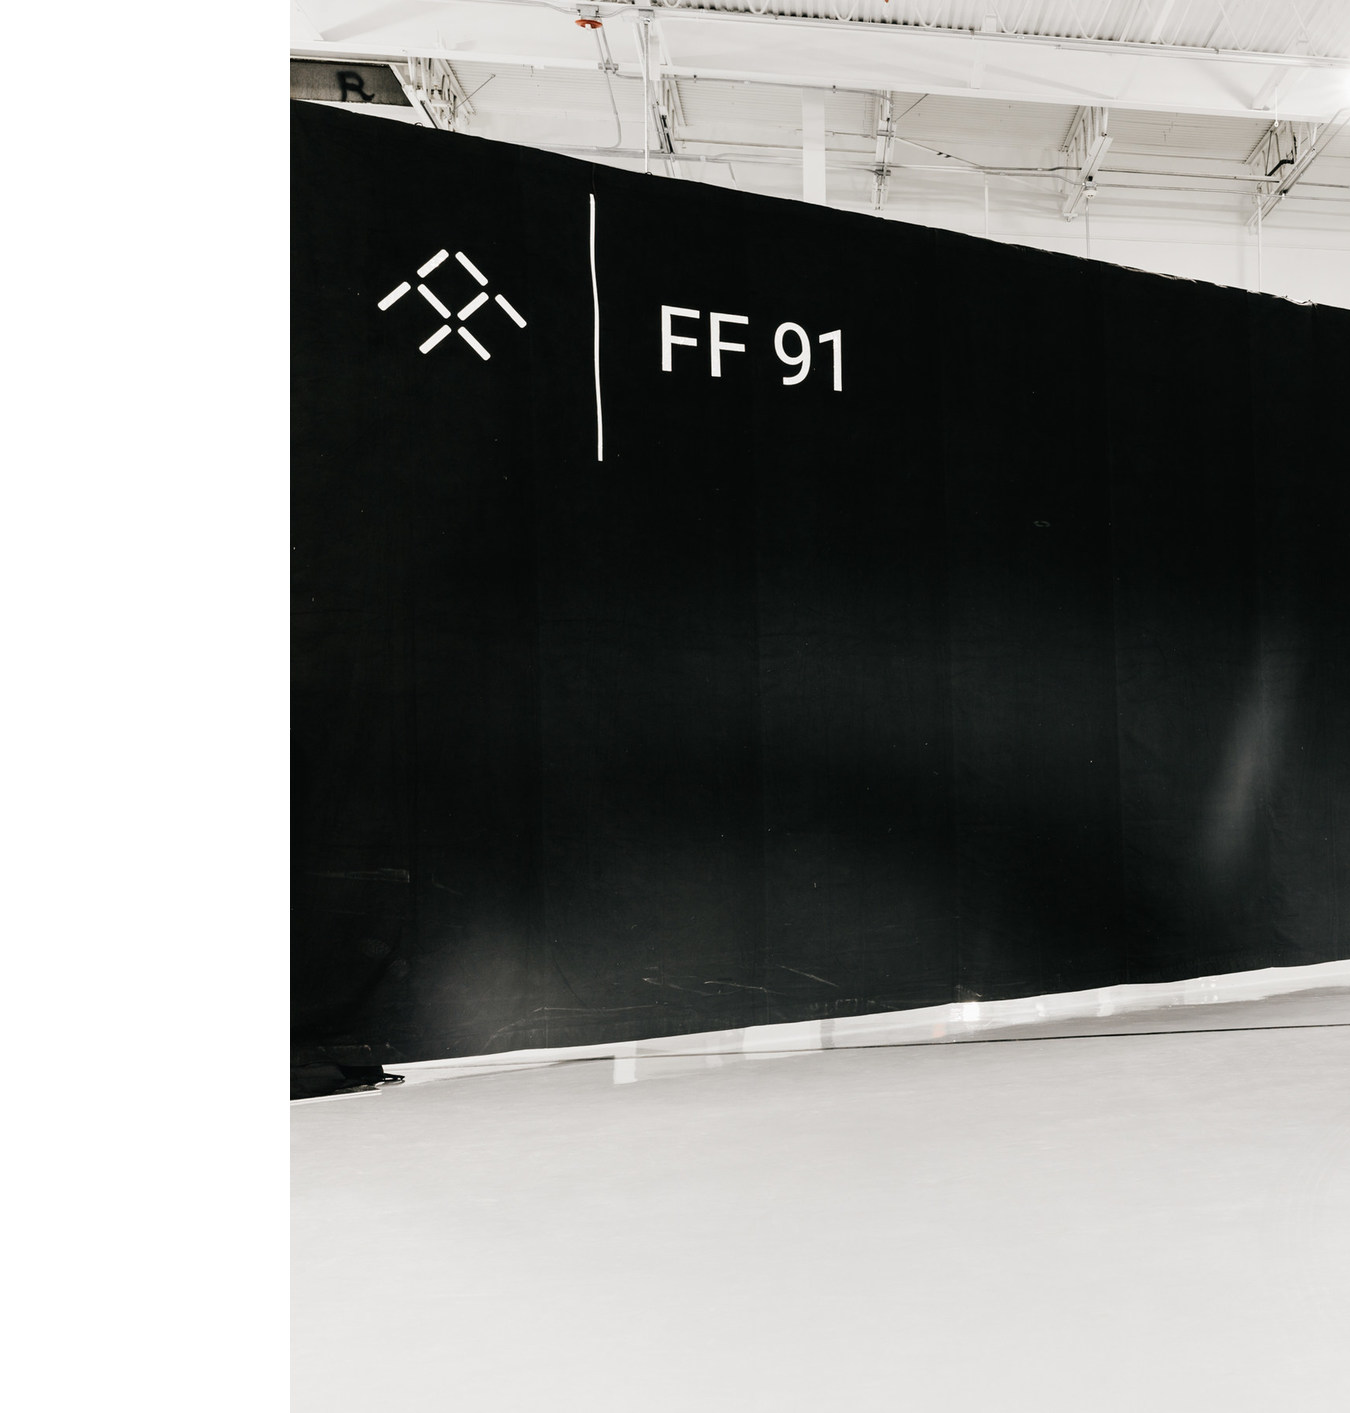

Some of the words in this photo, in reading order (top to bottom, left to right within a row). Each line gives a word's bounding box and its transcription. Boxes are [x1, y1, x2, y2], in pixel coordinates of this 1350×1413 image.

[337, 70, 376, 102] R
[660, 304, 750, 379] FF
[773, 321, 844, 393] 91
